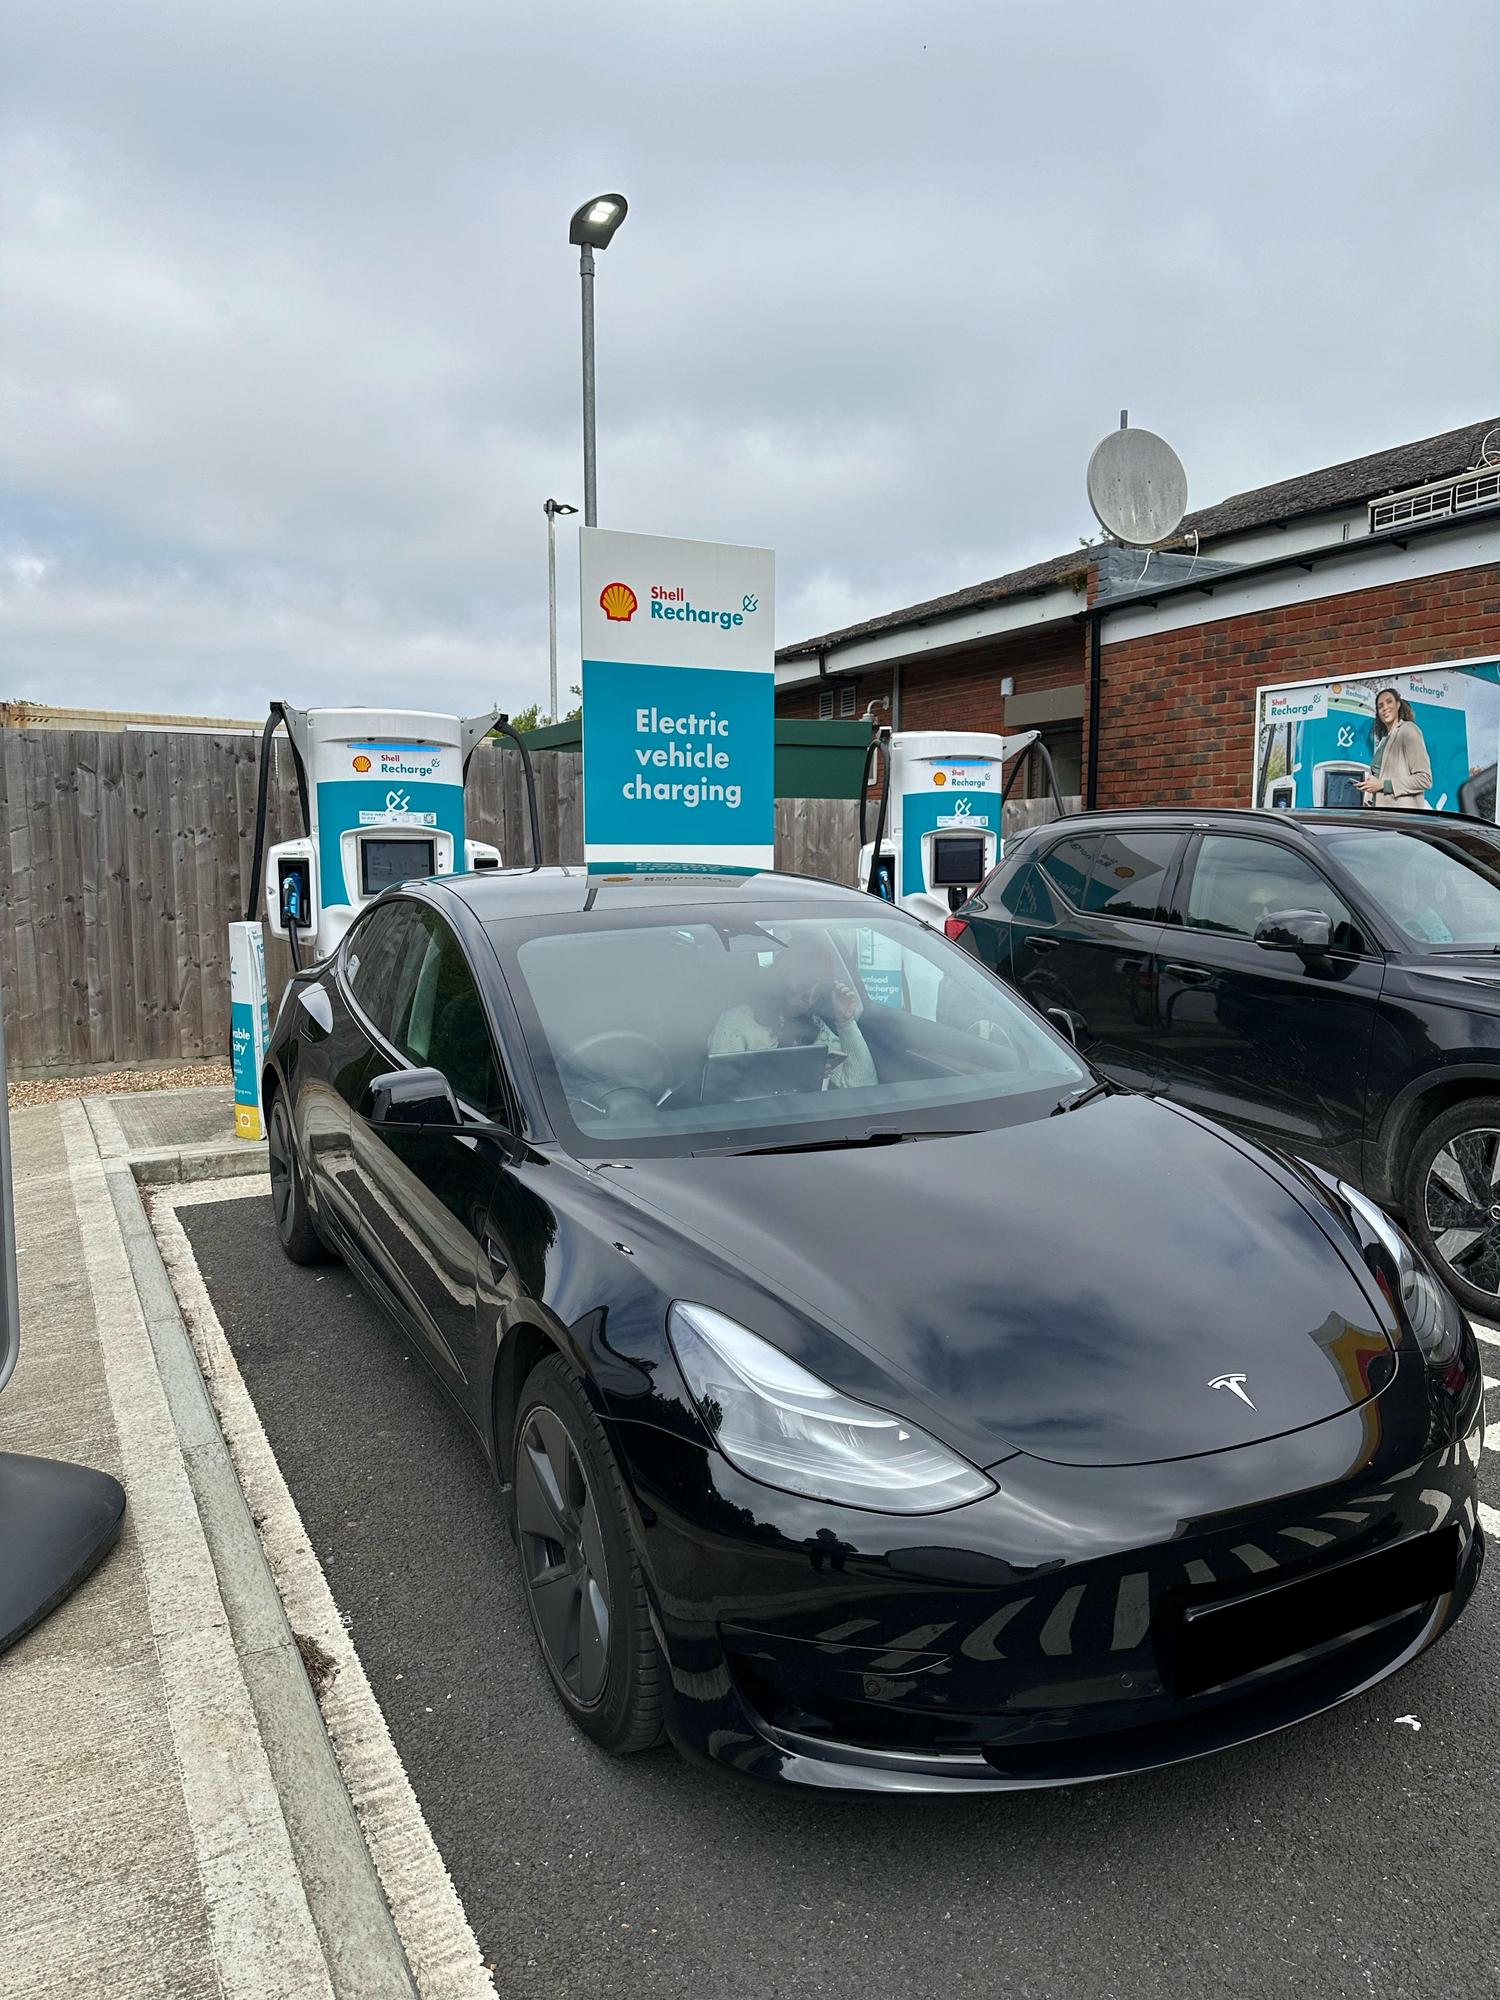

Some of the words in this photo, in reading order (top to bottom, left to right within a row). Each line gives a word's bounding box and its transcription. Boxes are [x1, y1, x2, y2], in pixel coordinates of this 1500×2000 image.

[651, 586, 684, 602] Shell
[651, 600, 744, 630] Recharge
[1409, 682, 1445, 699] Recharge
[1271, 697, 1287, 707] Shell
[1271, 703, 1314, 716] Recharge
[636, 707, 729, 737] Electric
[635, 741, 730, 769] vehicle
[381, 763, 432, 776] Recharge
[622, 773, 742, 809] charging
[951, 778, 985, 788] Recharge
